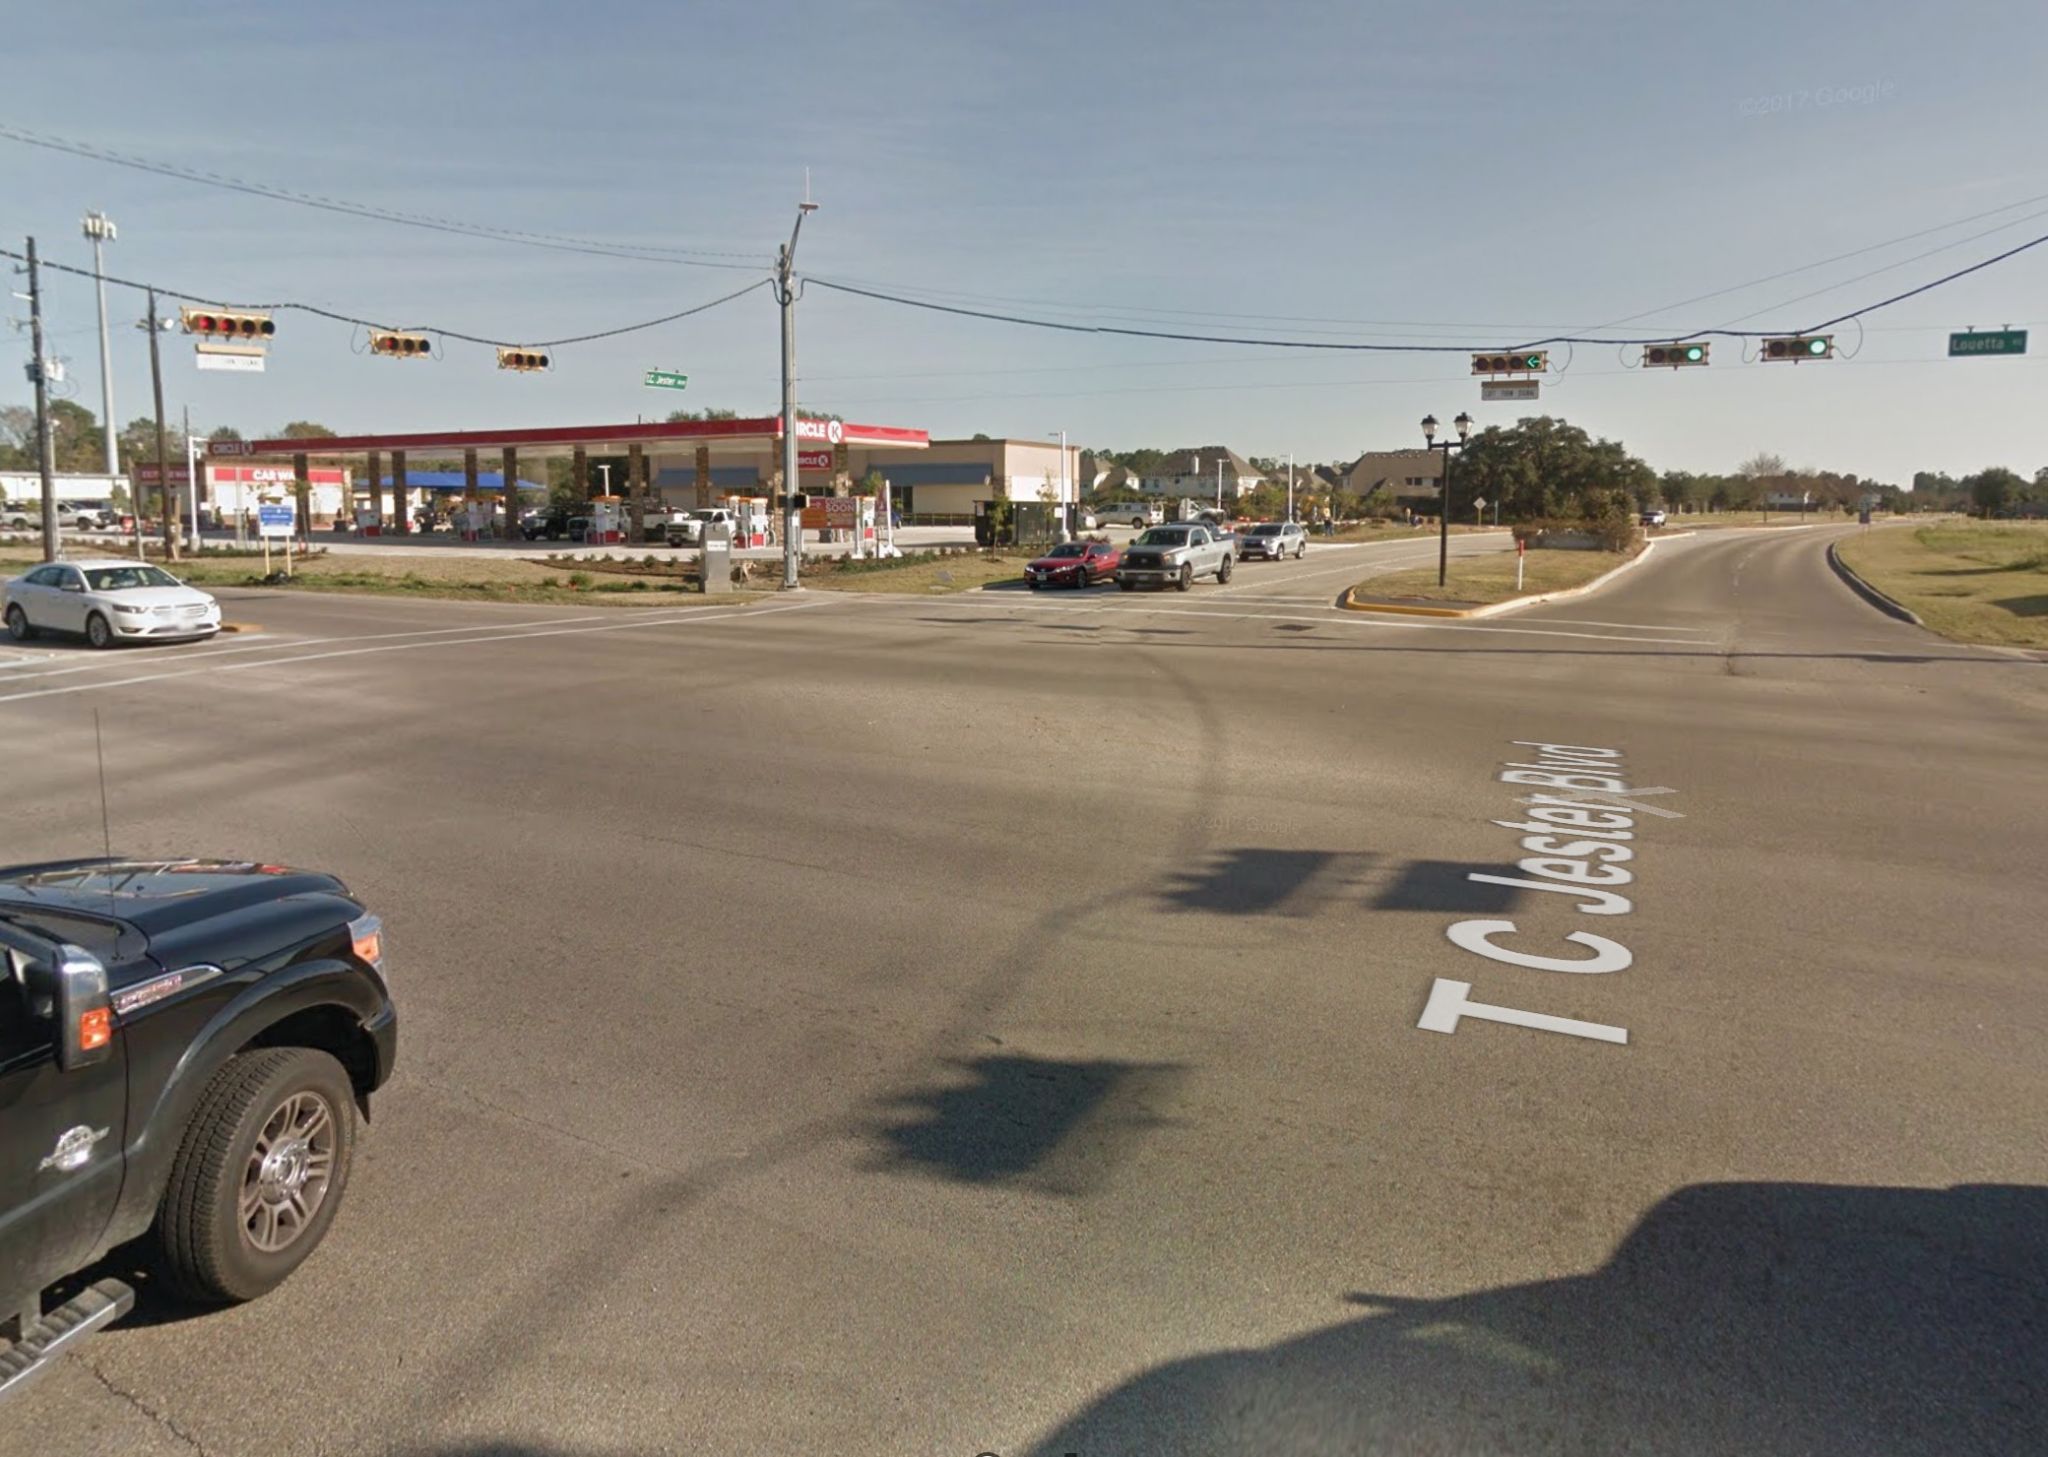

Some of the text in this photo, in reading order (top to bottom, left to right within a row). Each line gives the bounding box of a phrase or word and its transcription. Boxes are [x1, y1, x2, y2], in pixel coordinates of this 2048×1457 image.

[1952, 337, 2005, 351] Louetta
[795, 421, 826, 438] IRCLE
[253, 470, 296, 481] CAR WA
[825, 503, 855, 513] SOON
